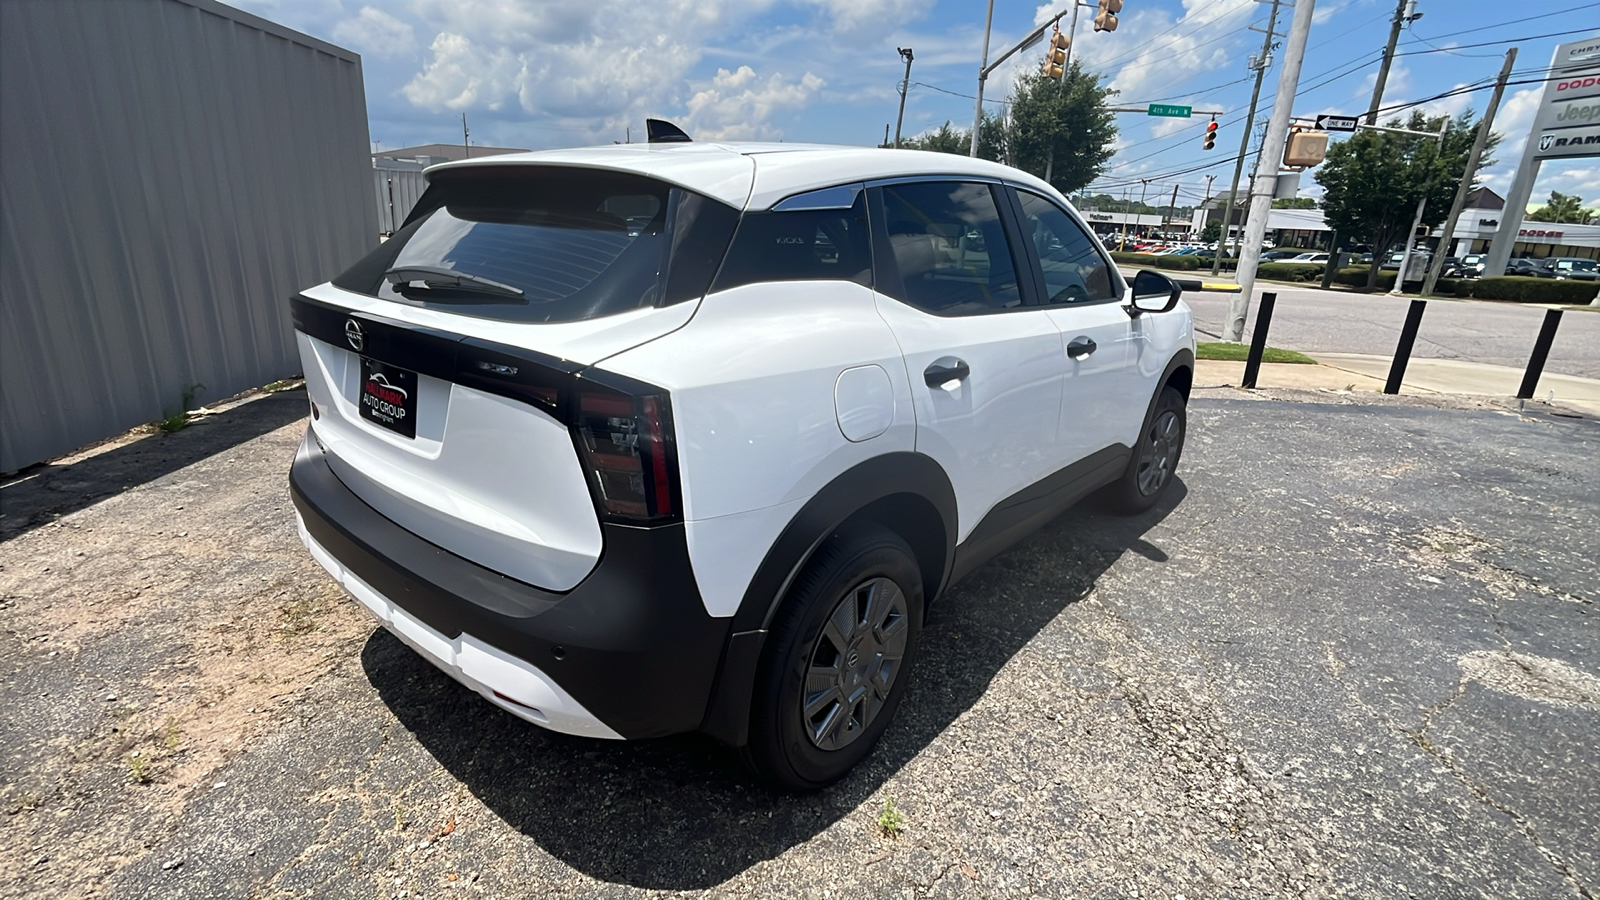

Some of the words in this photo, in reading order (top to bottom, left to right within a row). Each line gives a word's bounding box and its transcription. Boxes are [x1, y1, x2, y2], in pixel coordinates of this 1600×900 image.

[1557, 77, 1600, 91] DOD
[1152, 106, 1164, 114] 4th
[1555, 135, 1600, 147] RAM
[1519, 229, 1564, 238] DODGE
[365, 380, 404, 406] HALLMARK
[363, 392, 379, 409] AUTO
[380, 401, 406, 419] GROUP
